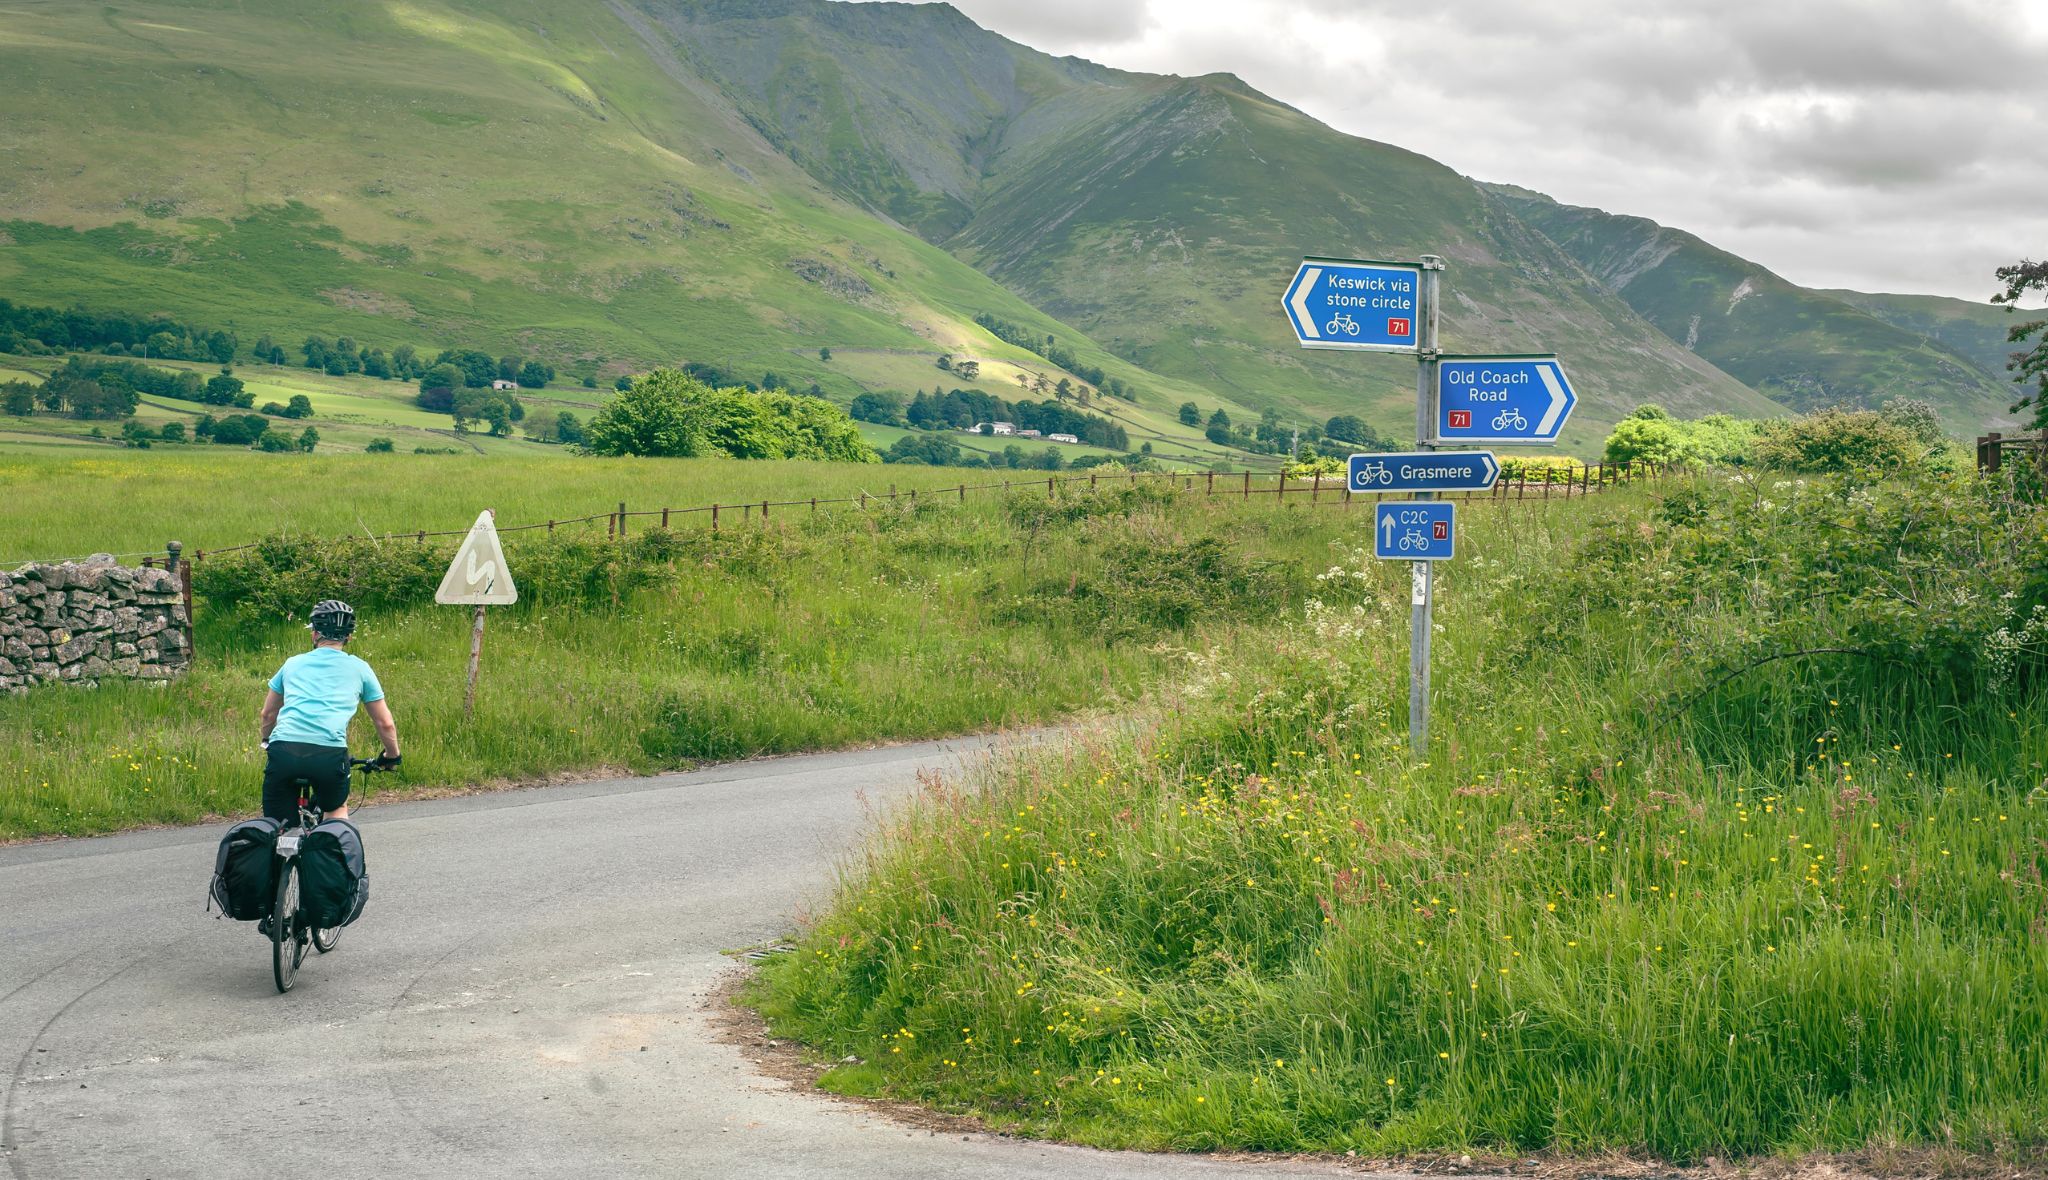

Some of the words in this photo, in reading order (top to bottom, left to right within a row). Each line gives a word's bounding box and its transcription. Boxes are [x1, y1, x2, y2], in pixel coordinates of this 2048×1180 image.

[1328, 274, 1386, 291] Keswick
[1391, 278, 1410, 292] via
[1327, 292, 1367, 307] stone
[1371, 295, 1411, 309] circle
[1392, 321, 1405, 334] 71
[1449, 370, 1475, 384] Old
[1481, 370, 1529, 384] Coach
[1469, 388, 1507, 402] Road
[1453, 413, 1467, 426] 71
[1400, 464, 1472, 480] Grasmere
[1400, 510, 1428, 525] C2C
[1434, 524, 1446, 537] 71
